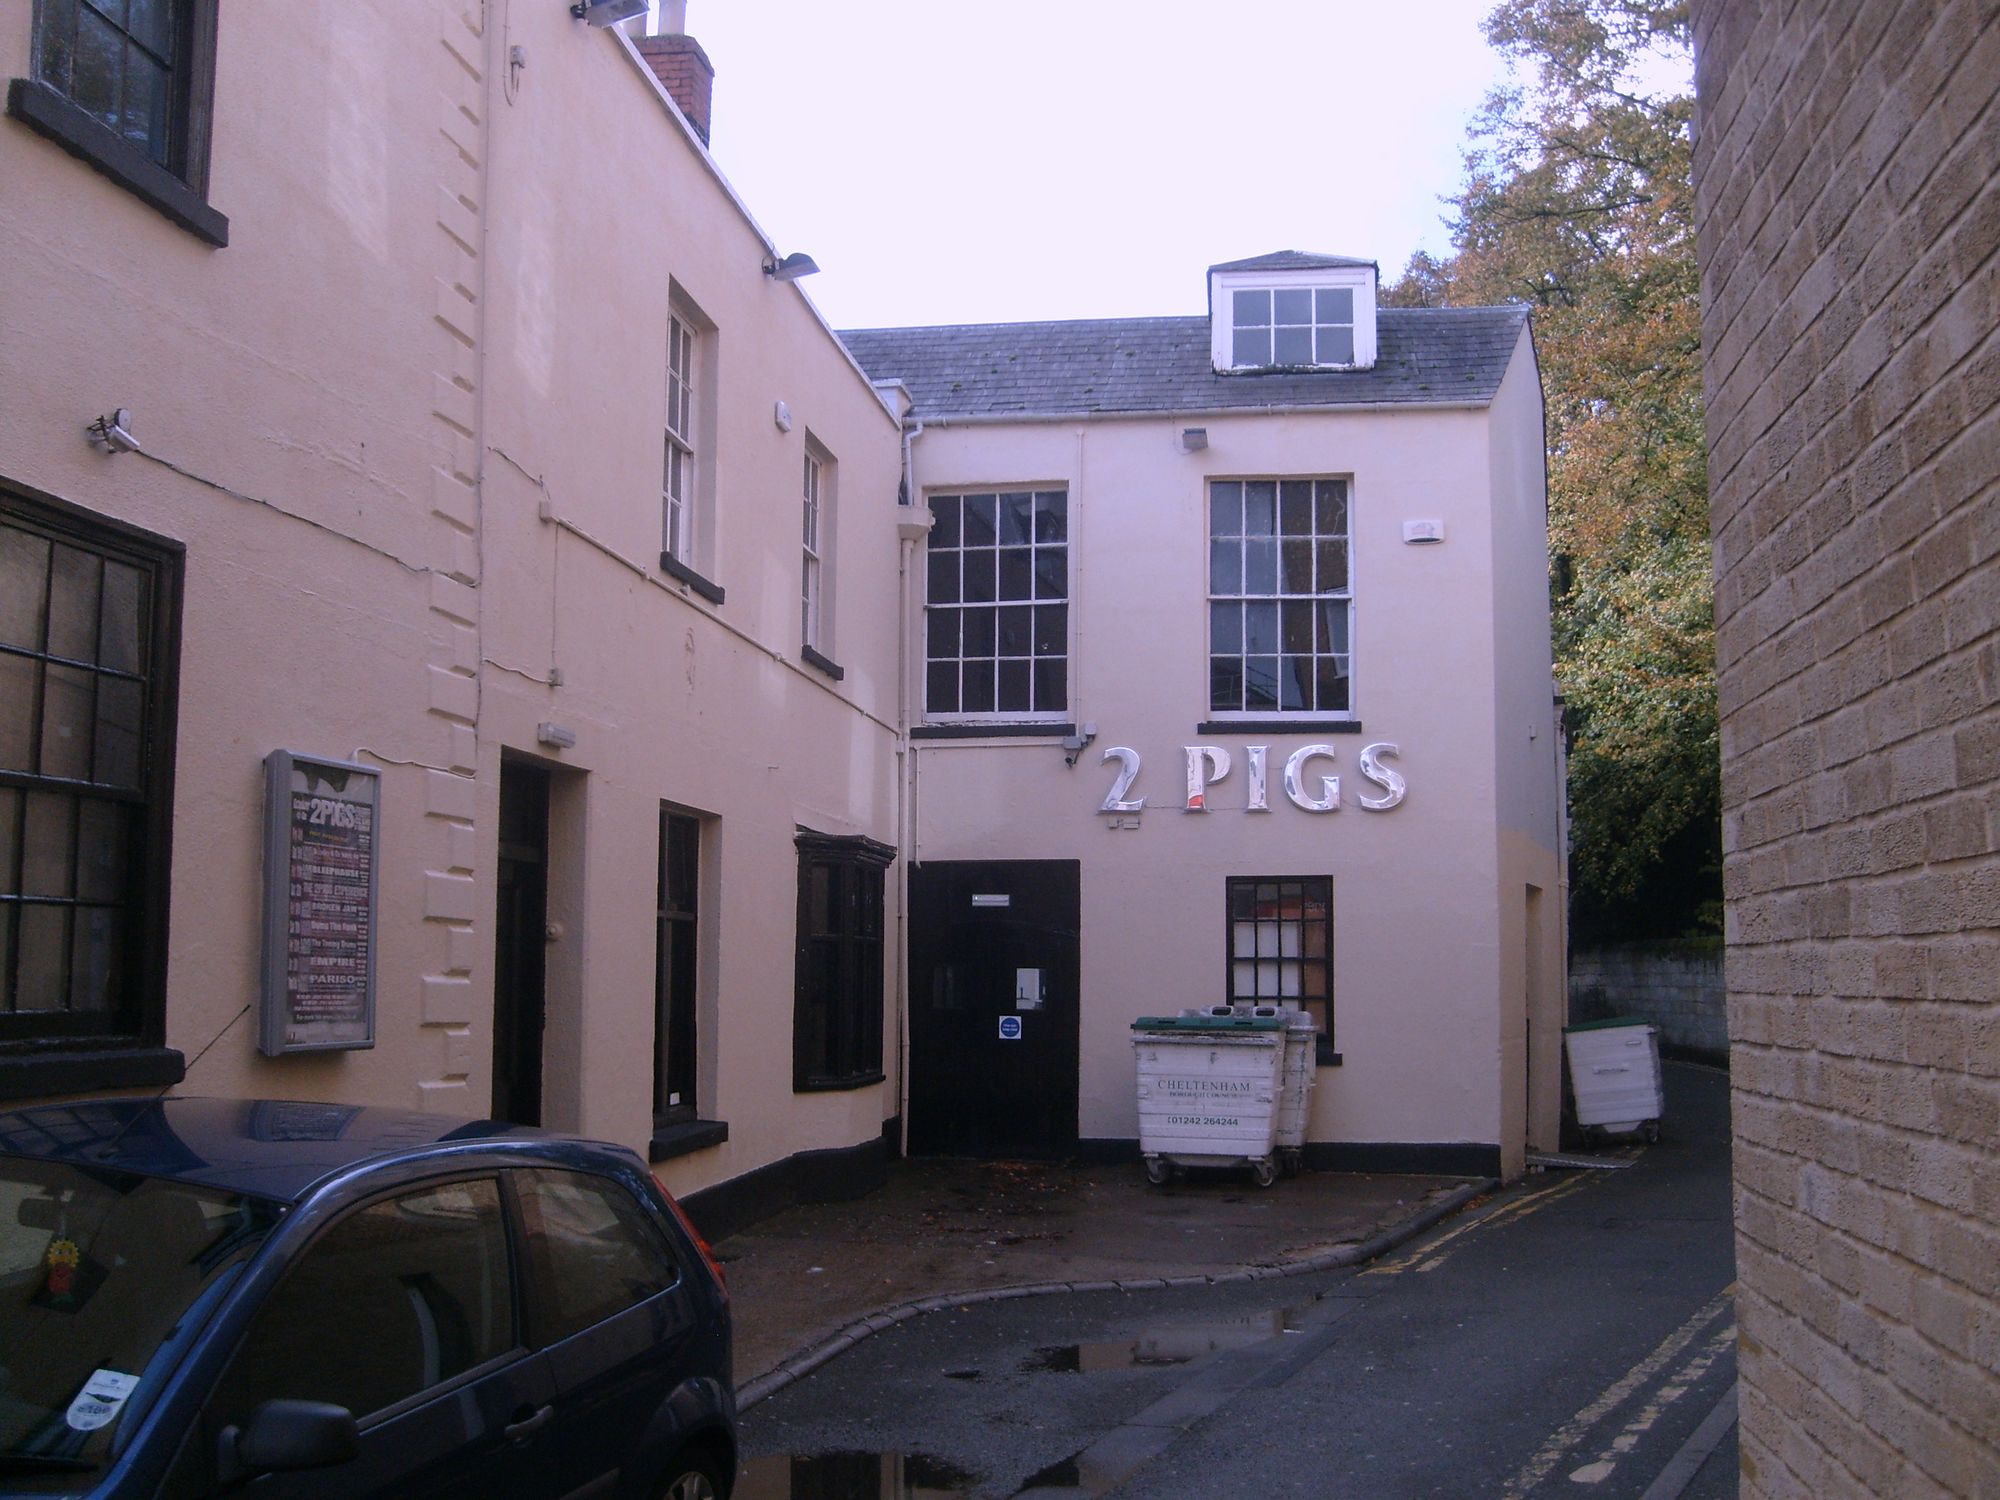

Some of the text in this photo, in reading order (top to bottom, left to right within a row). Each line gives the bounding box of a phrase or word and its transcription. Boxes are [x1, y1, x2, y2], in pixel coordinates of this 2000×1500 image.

[1096, 743, 1406, 815] 2 PIGS
[310, 957, 355, 967] EMPIRE
[1158, 1080, 1250, 1092] CHELTENHAM
